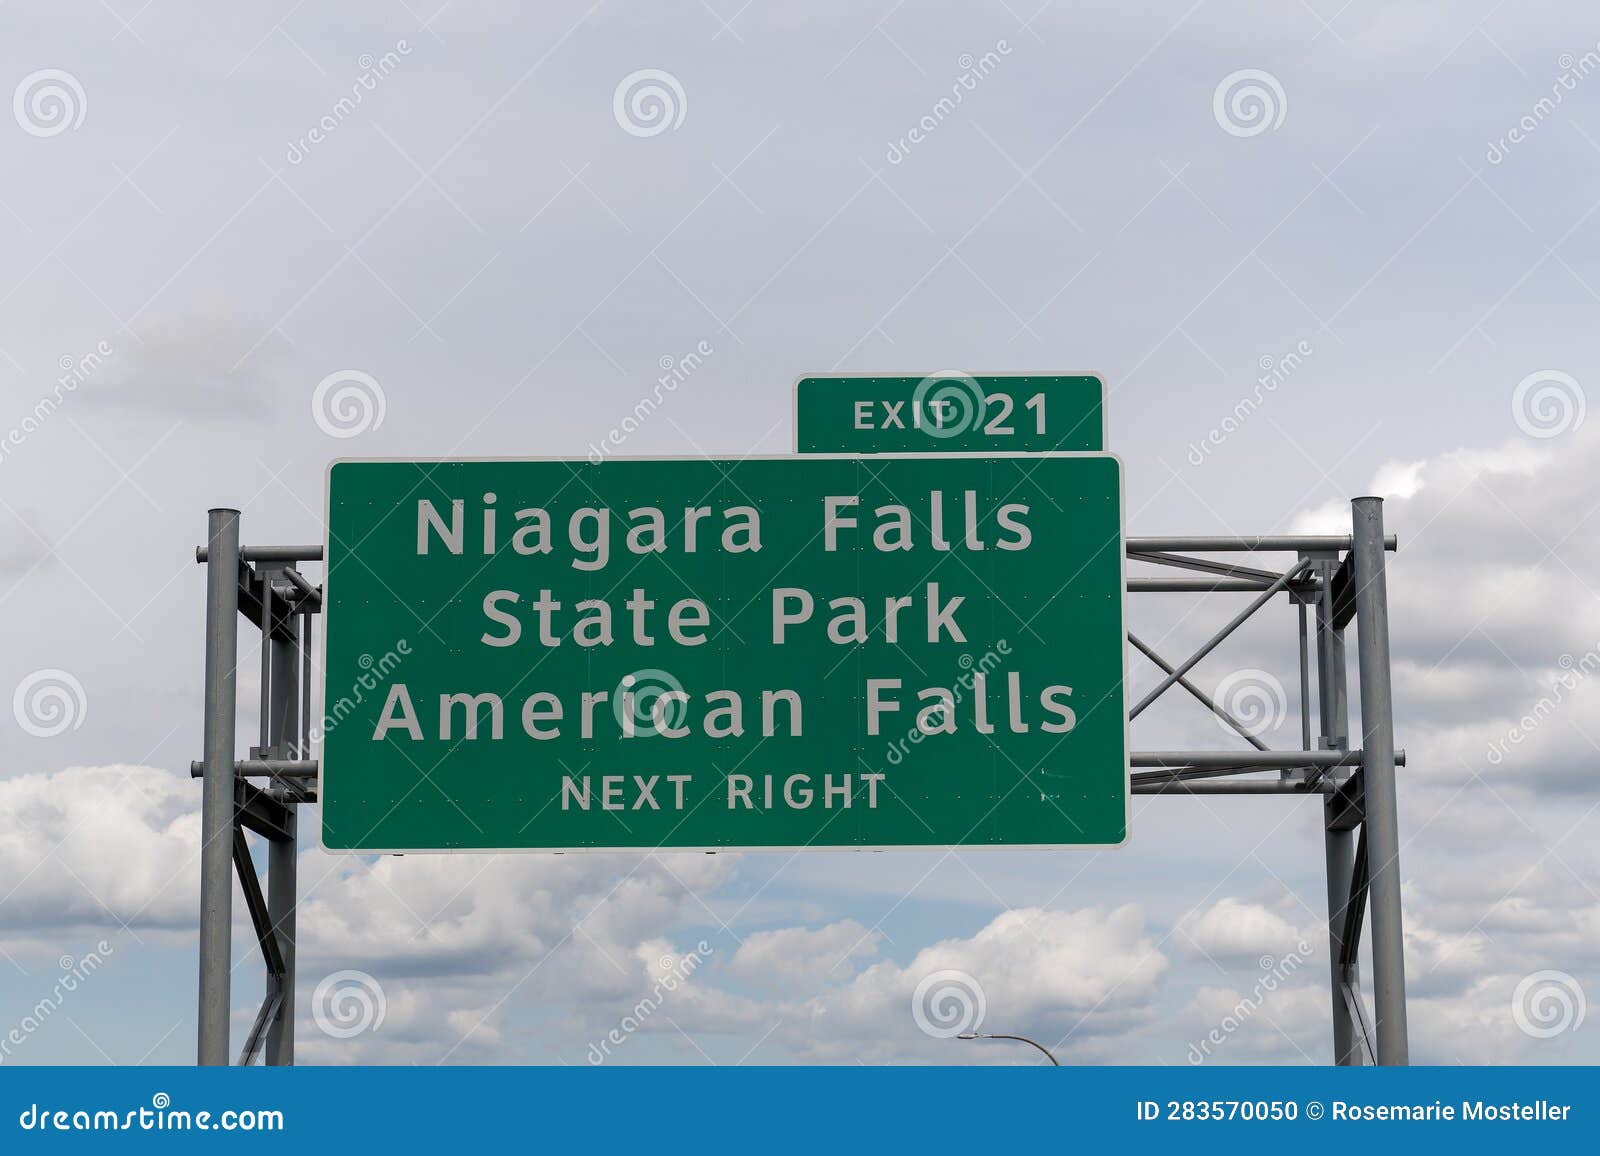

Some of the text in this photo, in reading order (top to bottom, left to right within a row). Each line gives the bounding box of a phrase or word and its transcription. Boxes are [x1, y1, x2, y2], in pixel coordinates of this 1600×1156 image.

[854, 393, 1046, 435] EXIT 21
[416, 490, 1032, 571] Niagara Falls
[480, 582, 967, 647] State Park
[372, 671, 1077, 741] American Falls
[561, 773, 886, 811] NEXT RIGHT
